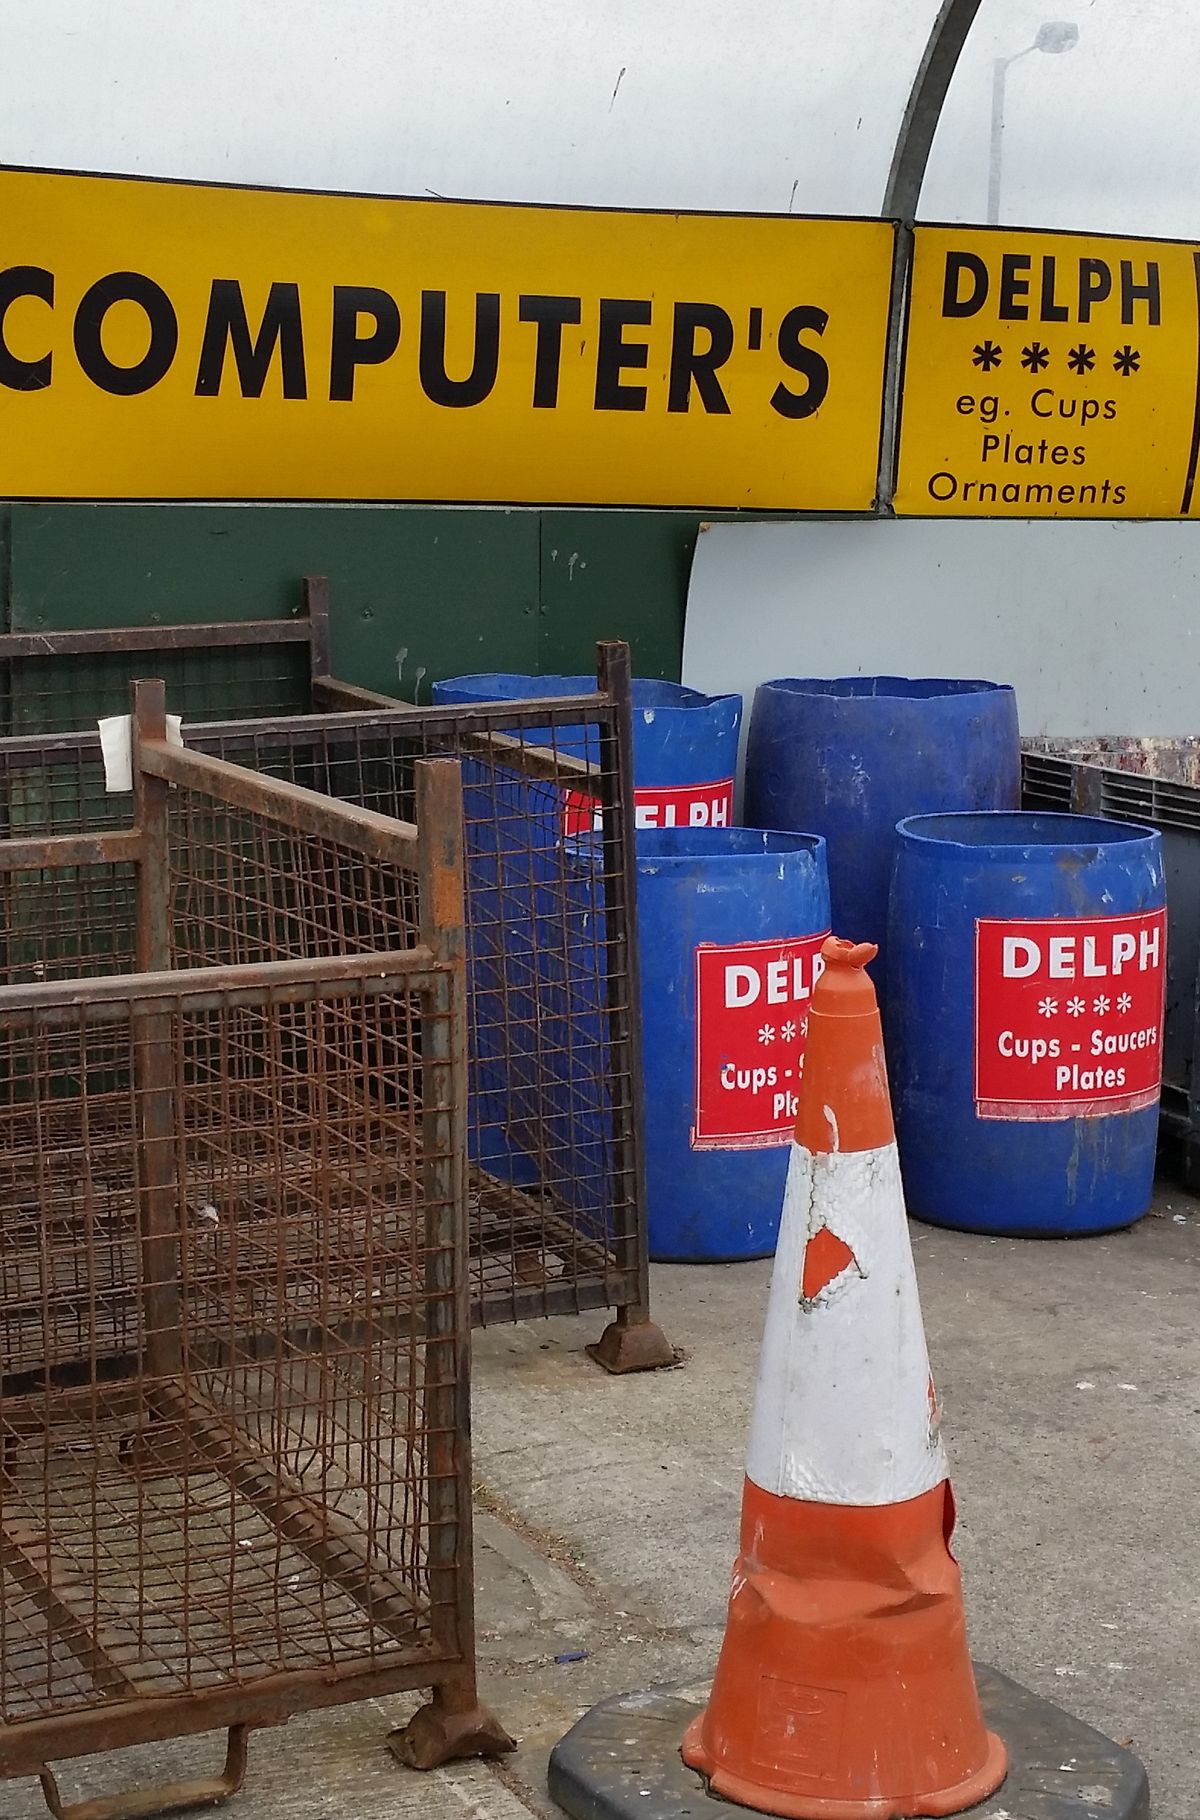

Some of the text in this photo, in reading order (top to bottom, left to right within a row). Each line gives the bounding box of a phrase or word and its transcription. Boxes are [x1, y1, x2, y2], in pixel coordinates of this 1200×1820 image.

[942, 251, 1161, 326] DELPH
[956, 388, 1117, 427] eg. Cups
[982, 434, 1087, 466] Plates
[928, 472, 1127, 505] Ornaments
[1002, 927, 1160, 979] DELPH
[725, 952, 825, 1009] DELP
[998, 1031, 1060, 1064] Cups
[1090, 1026, 1157, 1056] Saucers
[721, 1063, 778, 1095] Cups
[1056, 1064, 1126, 1091] Plates
